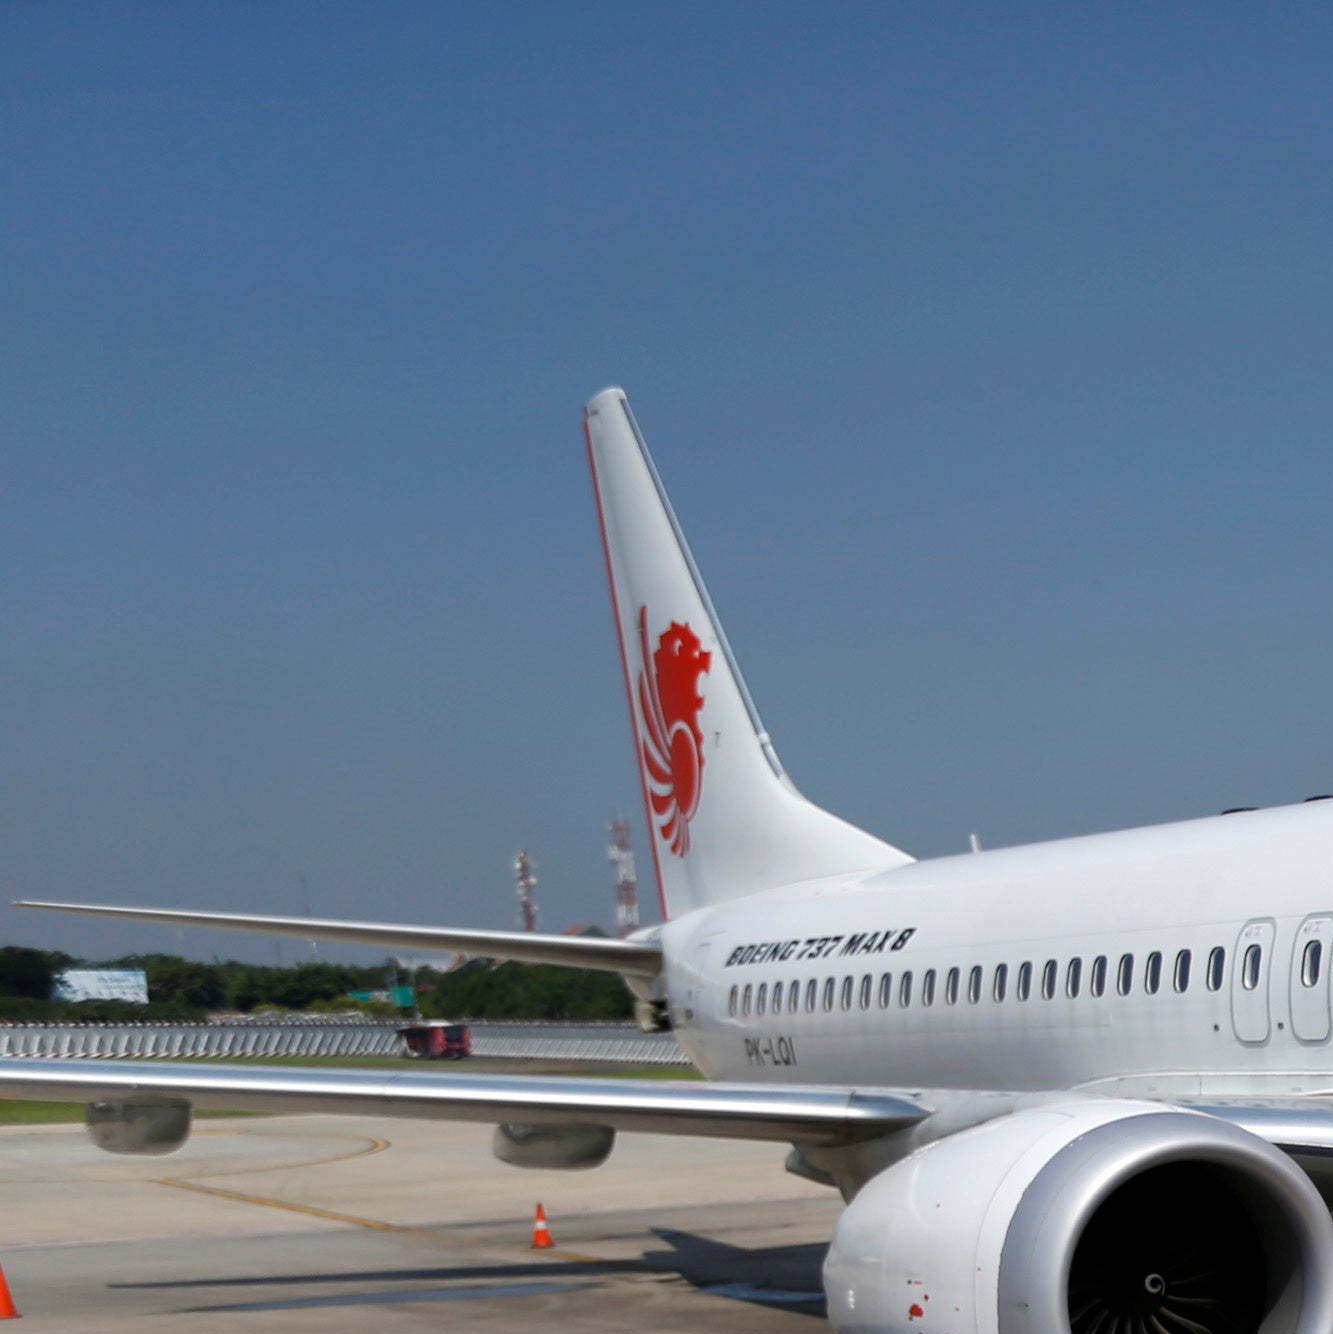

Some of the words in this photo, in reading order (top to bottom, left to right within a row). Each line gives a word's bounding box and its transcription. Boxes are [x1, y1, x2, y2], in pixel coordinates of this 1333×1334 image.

[725, 939, 800, 967] BOEING
[797, 935, 845, 960] 737
[840, 929, 898, 956] MAX
[891, 928, 916, 950] 8
[744, 1036, 797, 1066] PK-LQI
